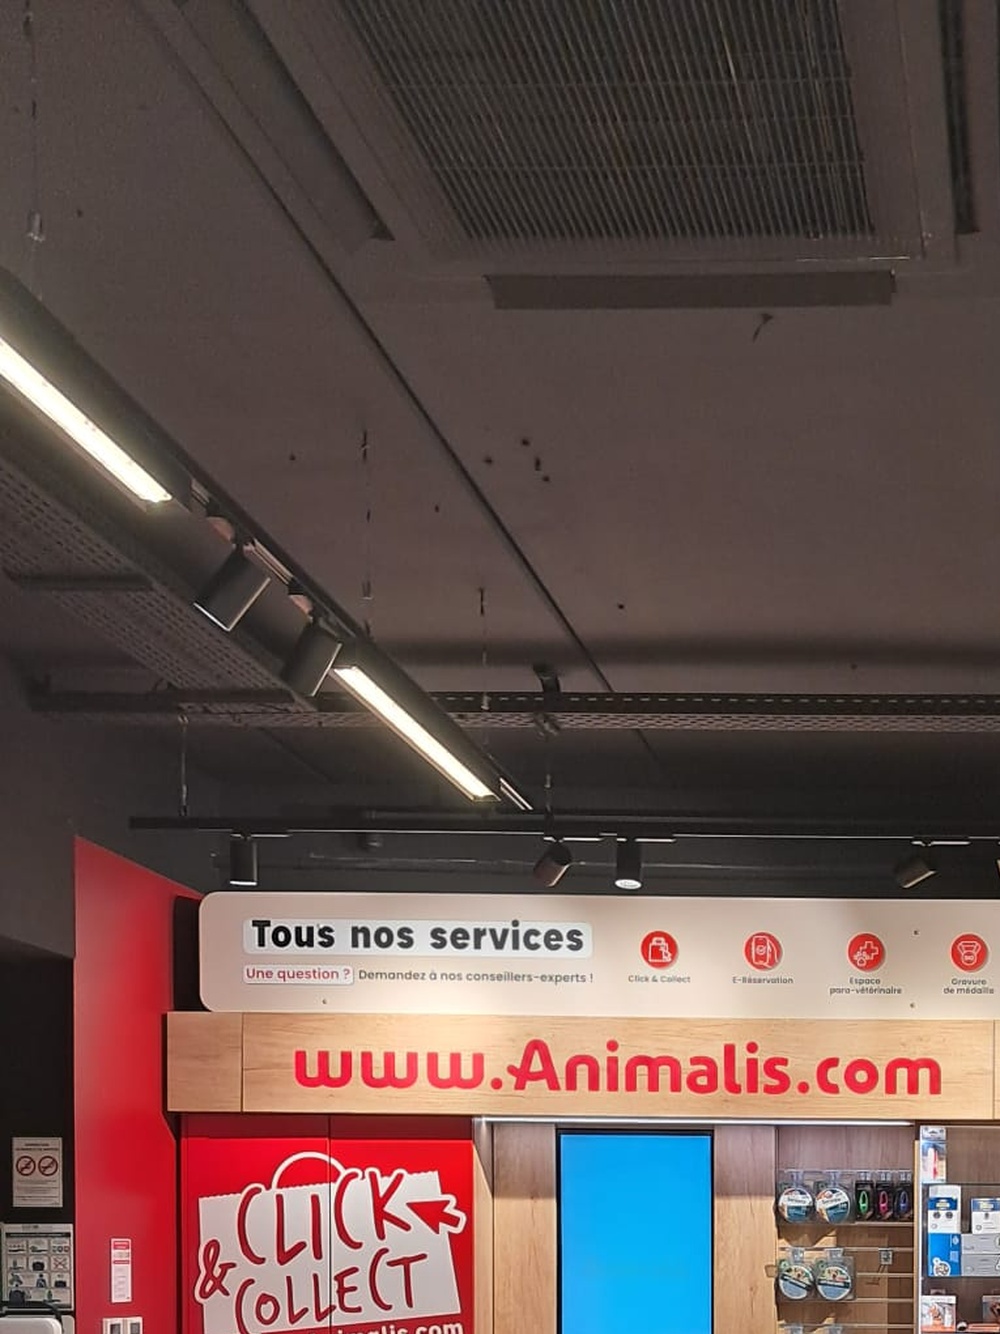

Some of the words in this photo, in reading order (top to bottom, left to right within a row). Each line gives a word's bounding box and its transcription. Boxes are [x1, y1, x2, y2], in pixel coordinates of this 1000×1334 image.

[252, 919, 335, 950] Tous
[351, 921, 415, 950] nos
[430, 919, 584, 953] services
[246, 967, 275, 981] Une
[277, 967, 339, 984] question
[358, 969, 427, 982] Demandez
[440, 972, 463, 982] nos
[465, 969, 587, 985] conseillers-experts
[628, 974, 650, 984] Click
[659, 974, 691, 984] Collect
[732, 974, 794, 985] E-Réservation
[849, 977, 881, 987] Espace
[951, 977, 987, 987] Gravure
[829, 985, 902, 996] para-vétérinaire
[943, 985, 955, 995] de
[957, 985, 994, 995] médaille
[293, 1037, 942, 1096] www.Animalis.com
[237, 1168, 413, 1265] CLICK
[199, 1238, 236, 1299] &
